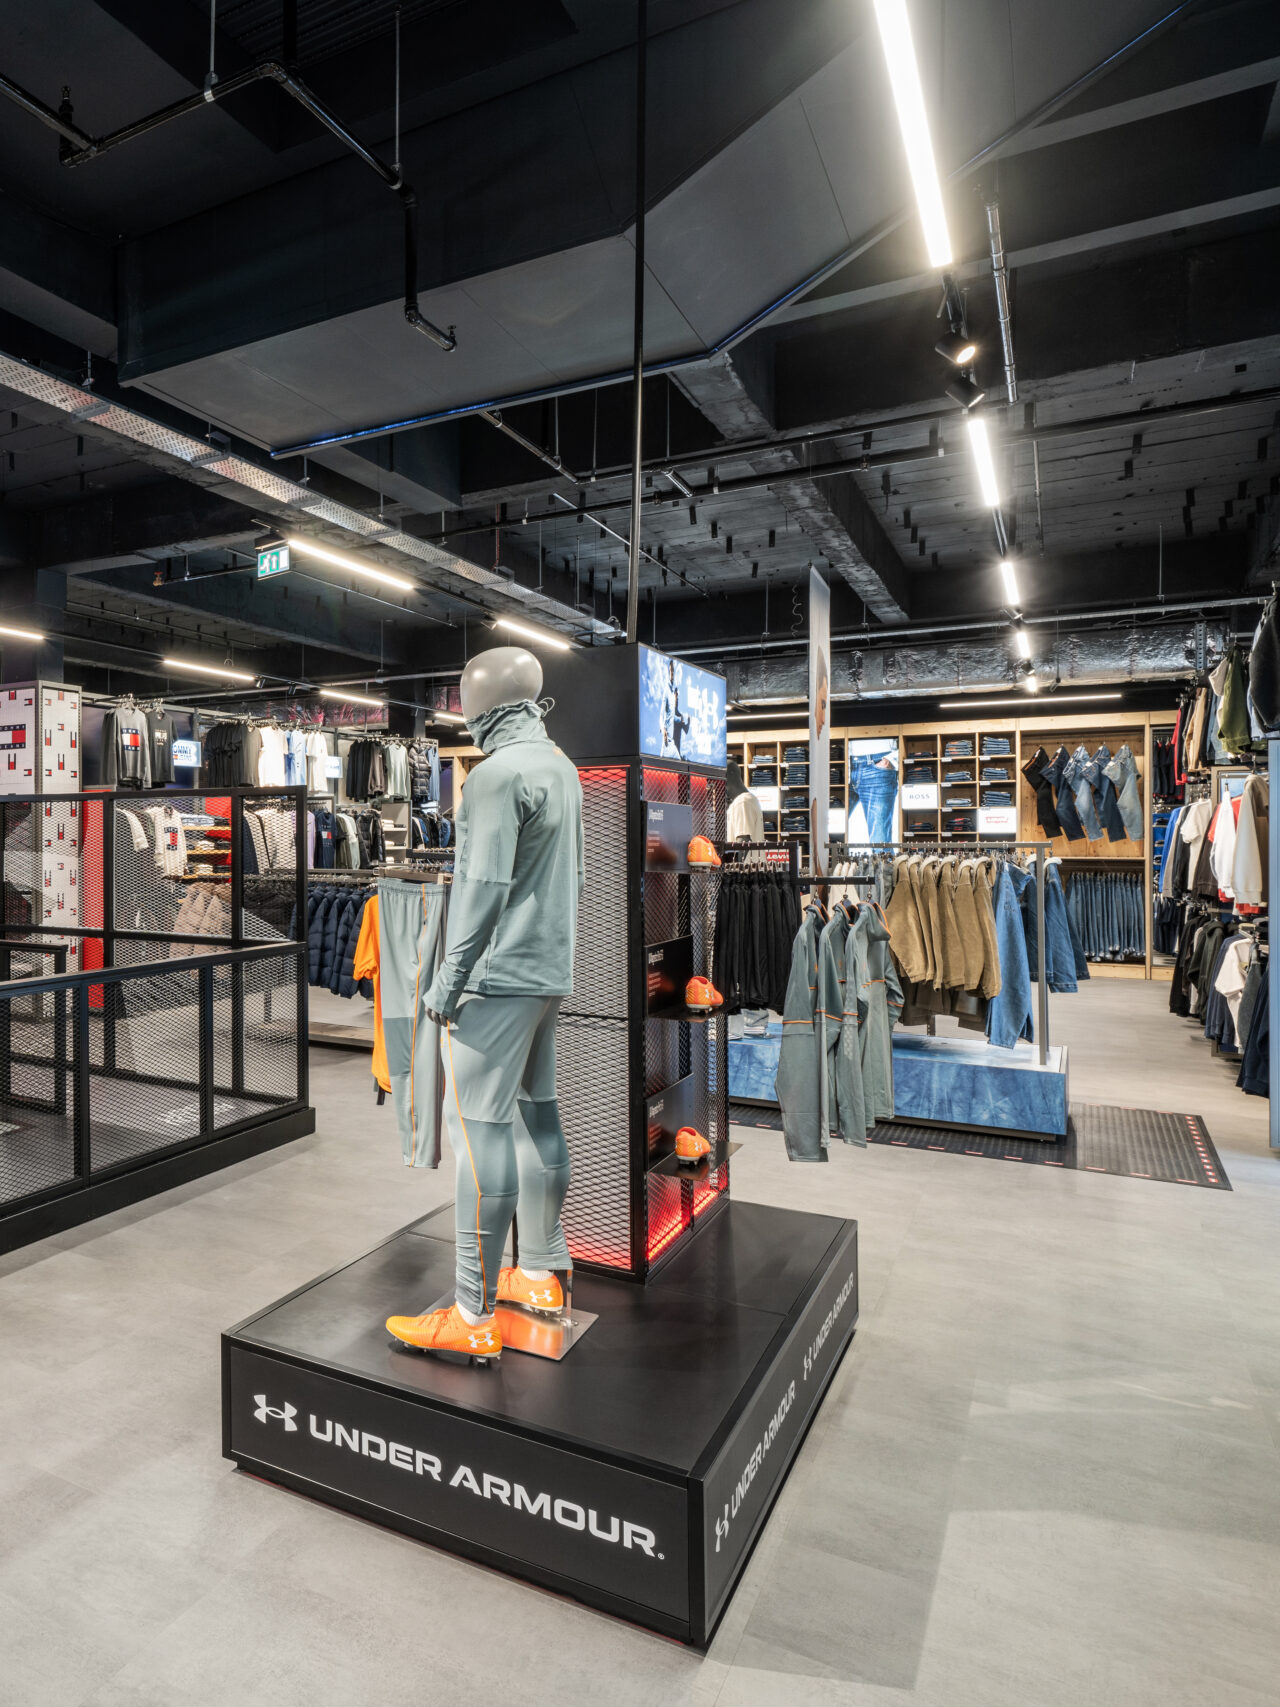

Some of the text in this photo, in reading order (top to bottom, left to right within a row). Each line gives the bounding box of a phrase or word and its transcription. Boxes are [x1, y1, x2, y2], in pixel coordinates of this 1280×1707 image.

[813, 1272, 854, 1360] UNDER ARMOUR
[310, 1413, 442, 1482] UNDER
[731, 1380, 796, 1518] UNDER ARMOUR
